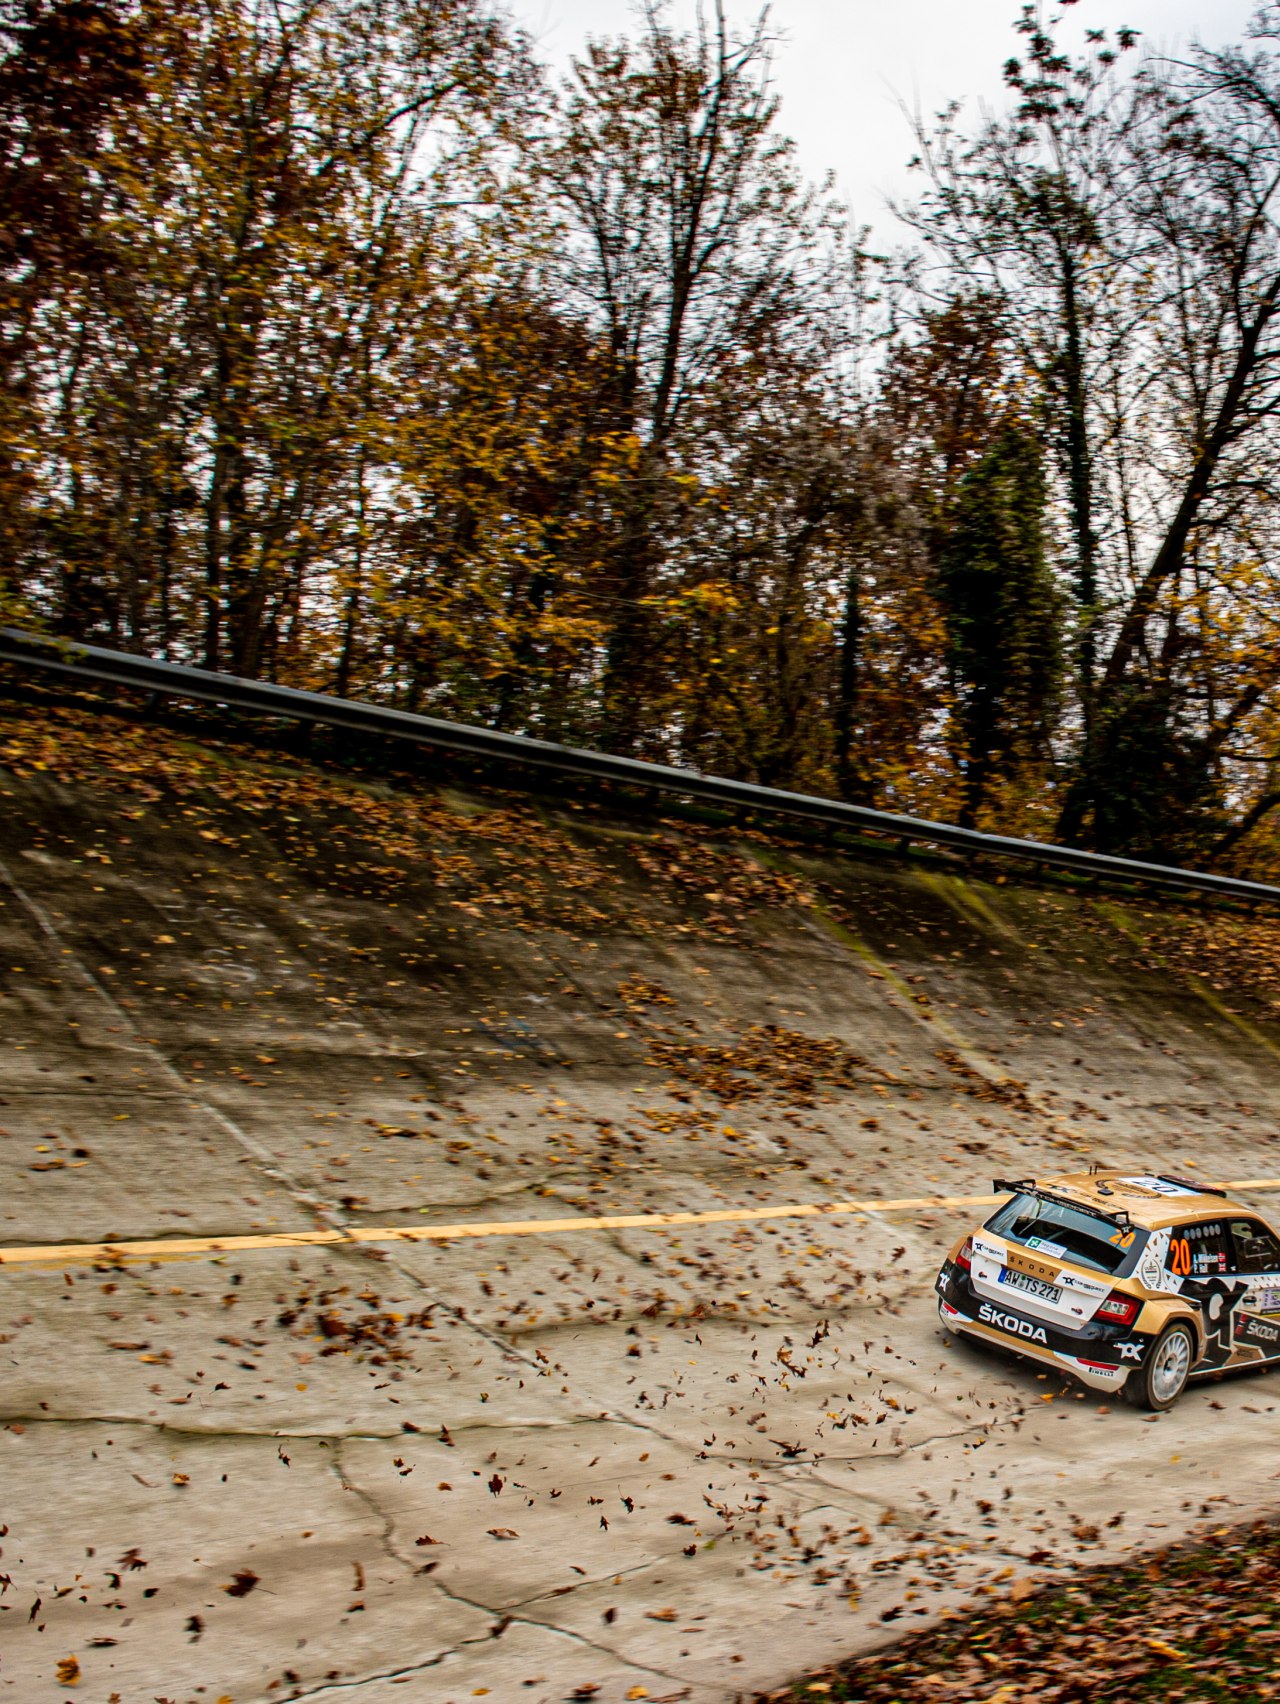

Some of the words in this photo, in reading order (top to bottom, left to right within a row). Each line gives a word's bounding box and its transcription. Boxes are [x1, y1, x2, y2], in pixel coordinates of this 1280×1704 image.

[1109, 1228, 1136, 1249] 20
[1170, 1238, 1191, 1276] 20
[978, 1303, 1048, 1344] ŠKODA
